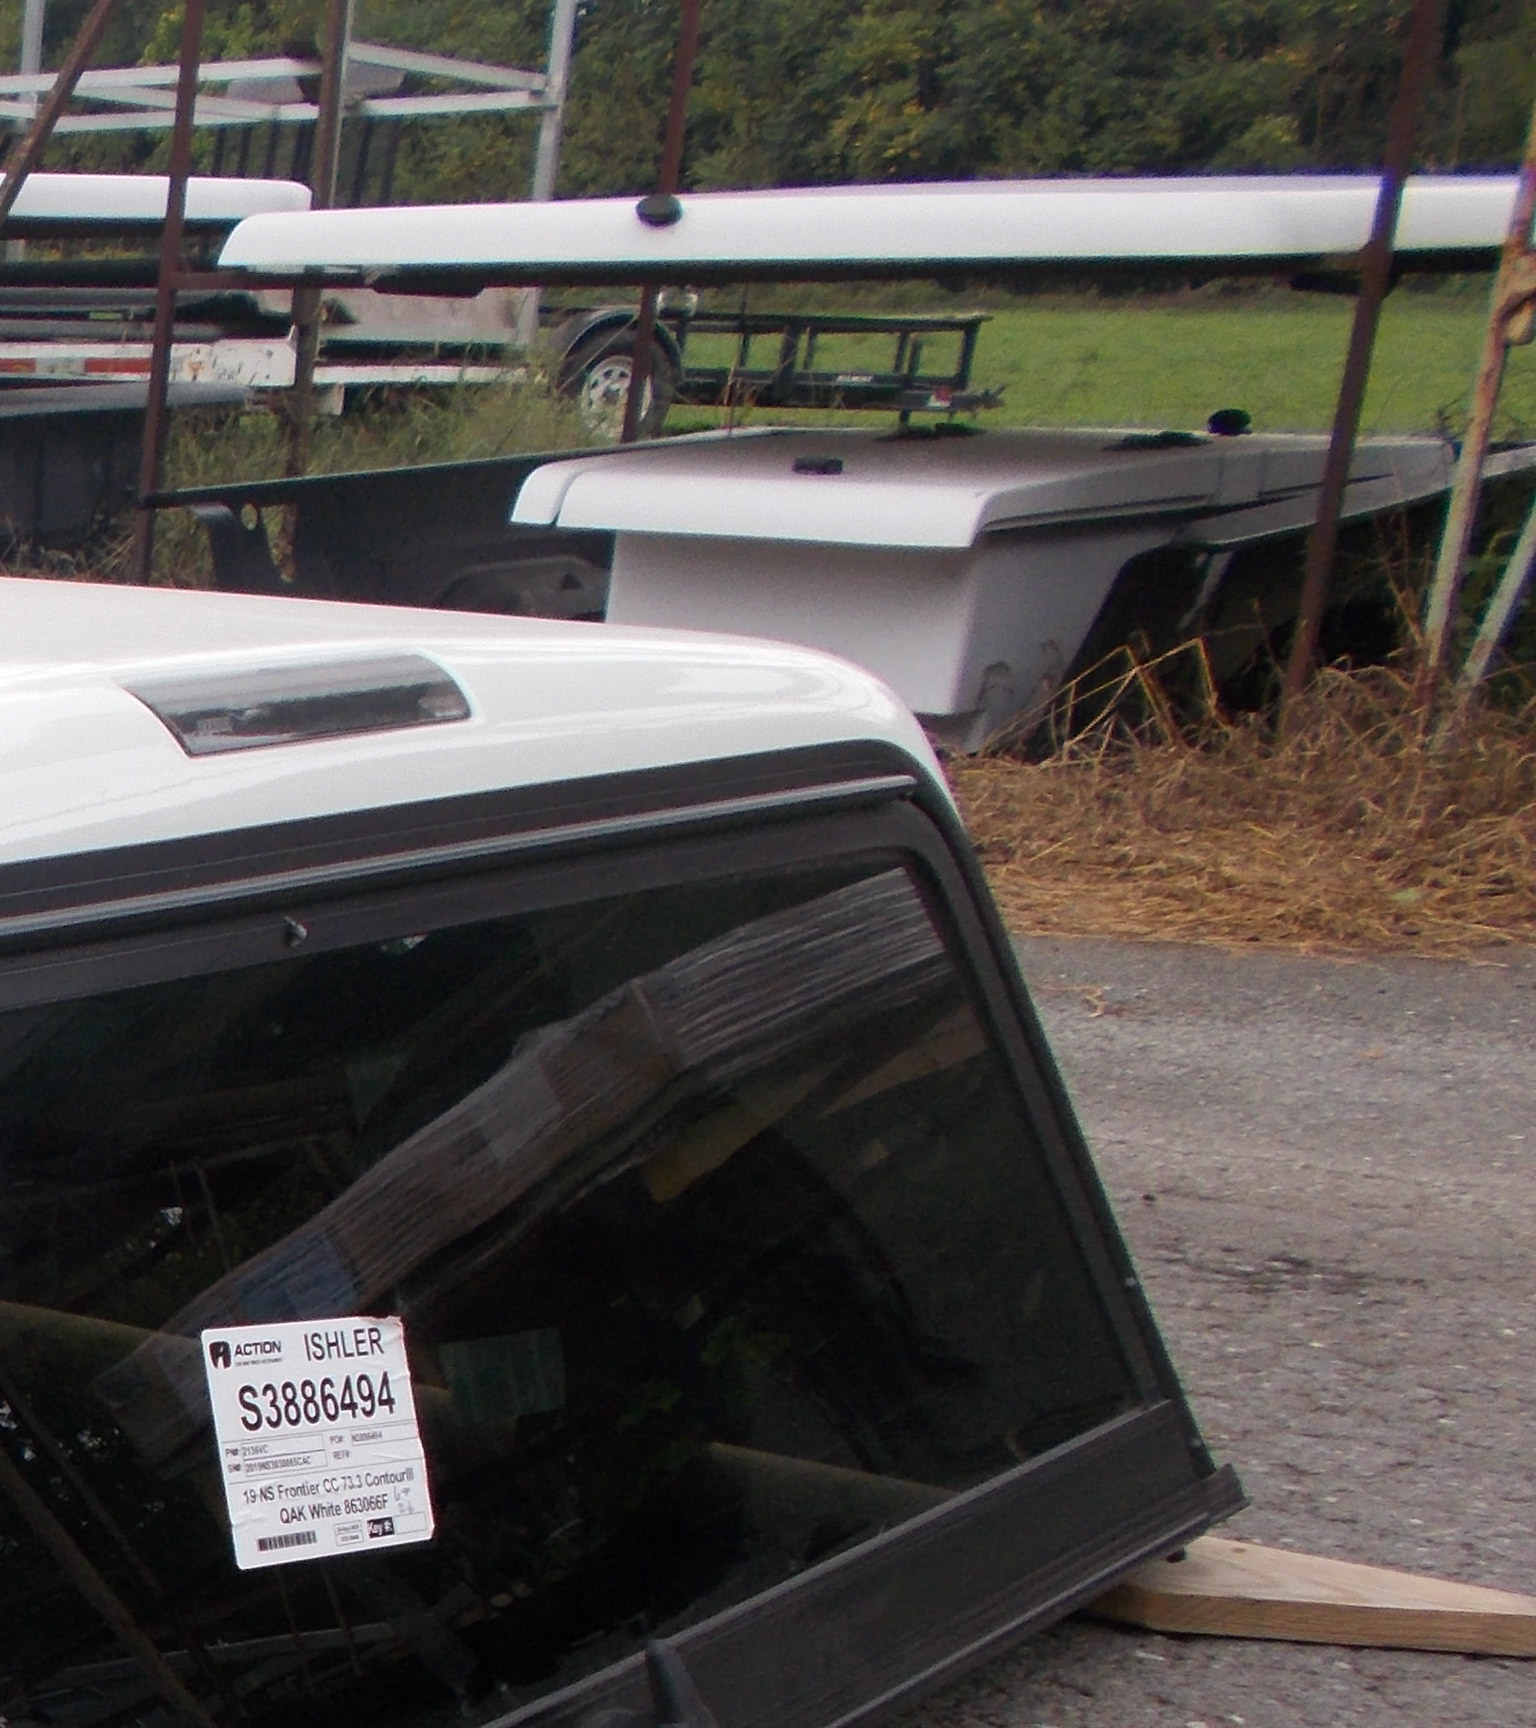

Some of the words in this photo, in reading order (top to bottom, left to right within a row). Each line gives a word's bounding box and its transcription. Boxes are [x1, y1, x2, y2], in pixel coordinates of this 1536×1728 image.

[234, 1340, 282, 1357] ACTION
[304, 1327, 384, 1362] ISHLER
[238, 1370, 396, 1432] S3886494
[243, 1489, 258, 1505] 19
[259, 1485, 275, 1501] NS
[277, 1480, 321, 1500] Frontier
[323, 1478, 339, 1494] CC
[340, 1475, 363, 1492] 73.3
[279, 1504, 307, 1525] QAK
[309, 1500, 342, 1521] White
[343, 1493, 389, 1516] 863066F
